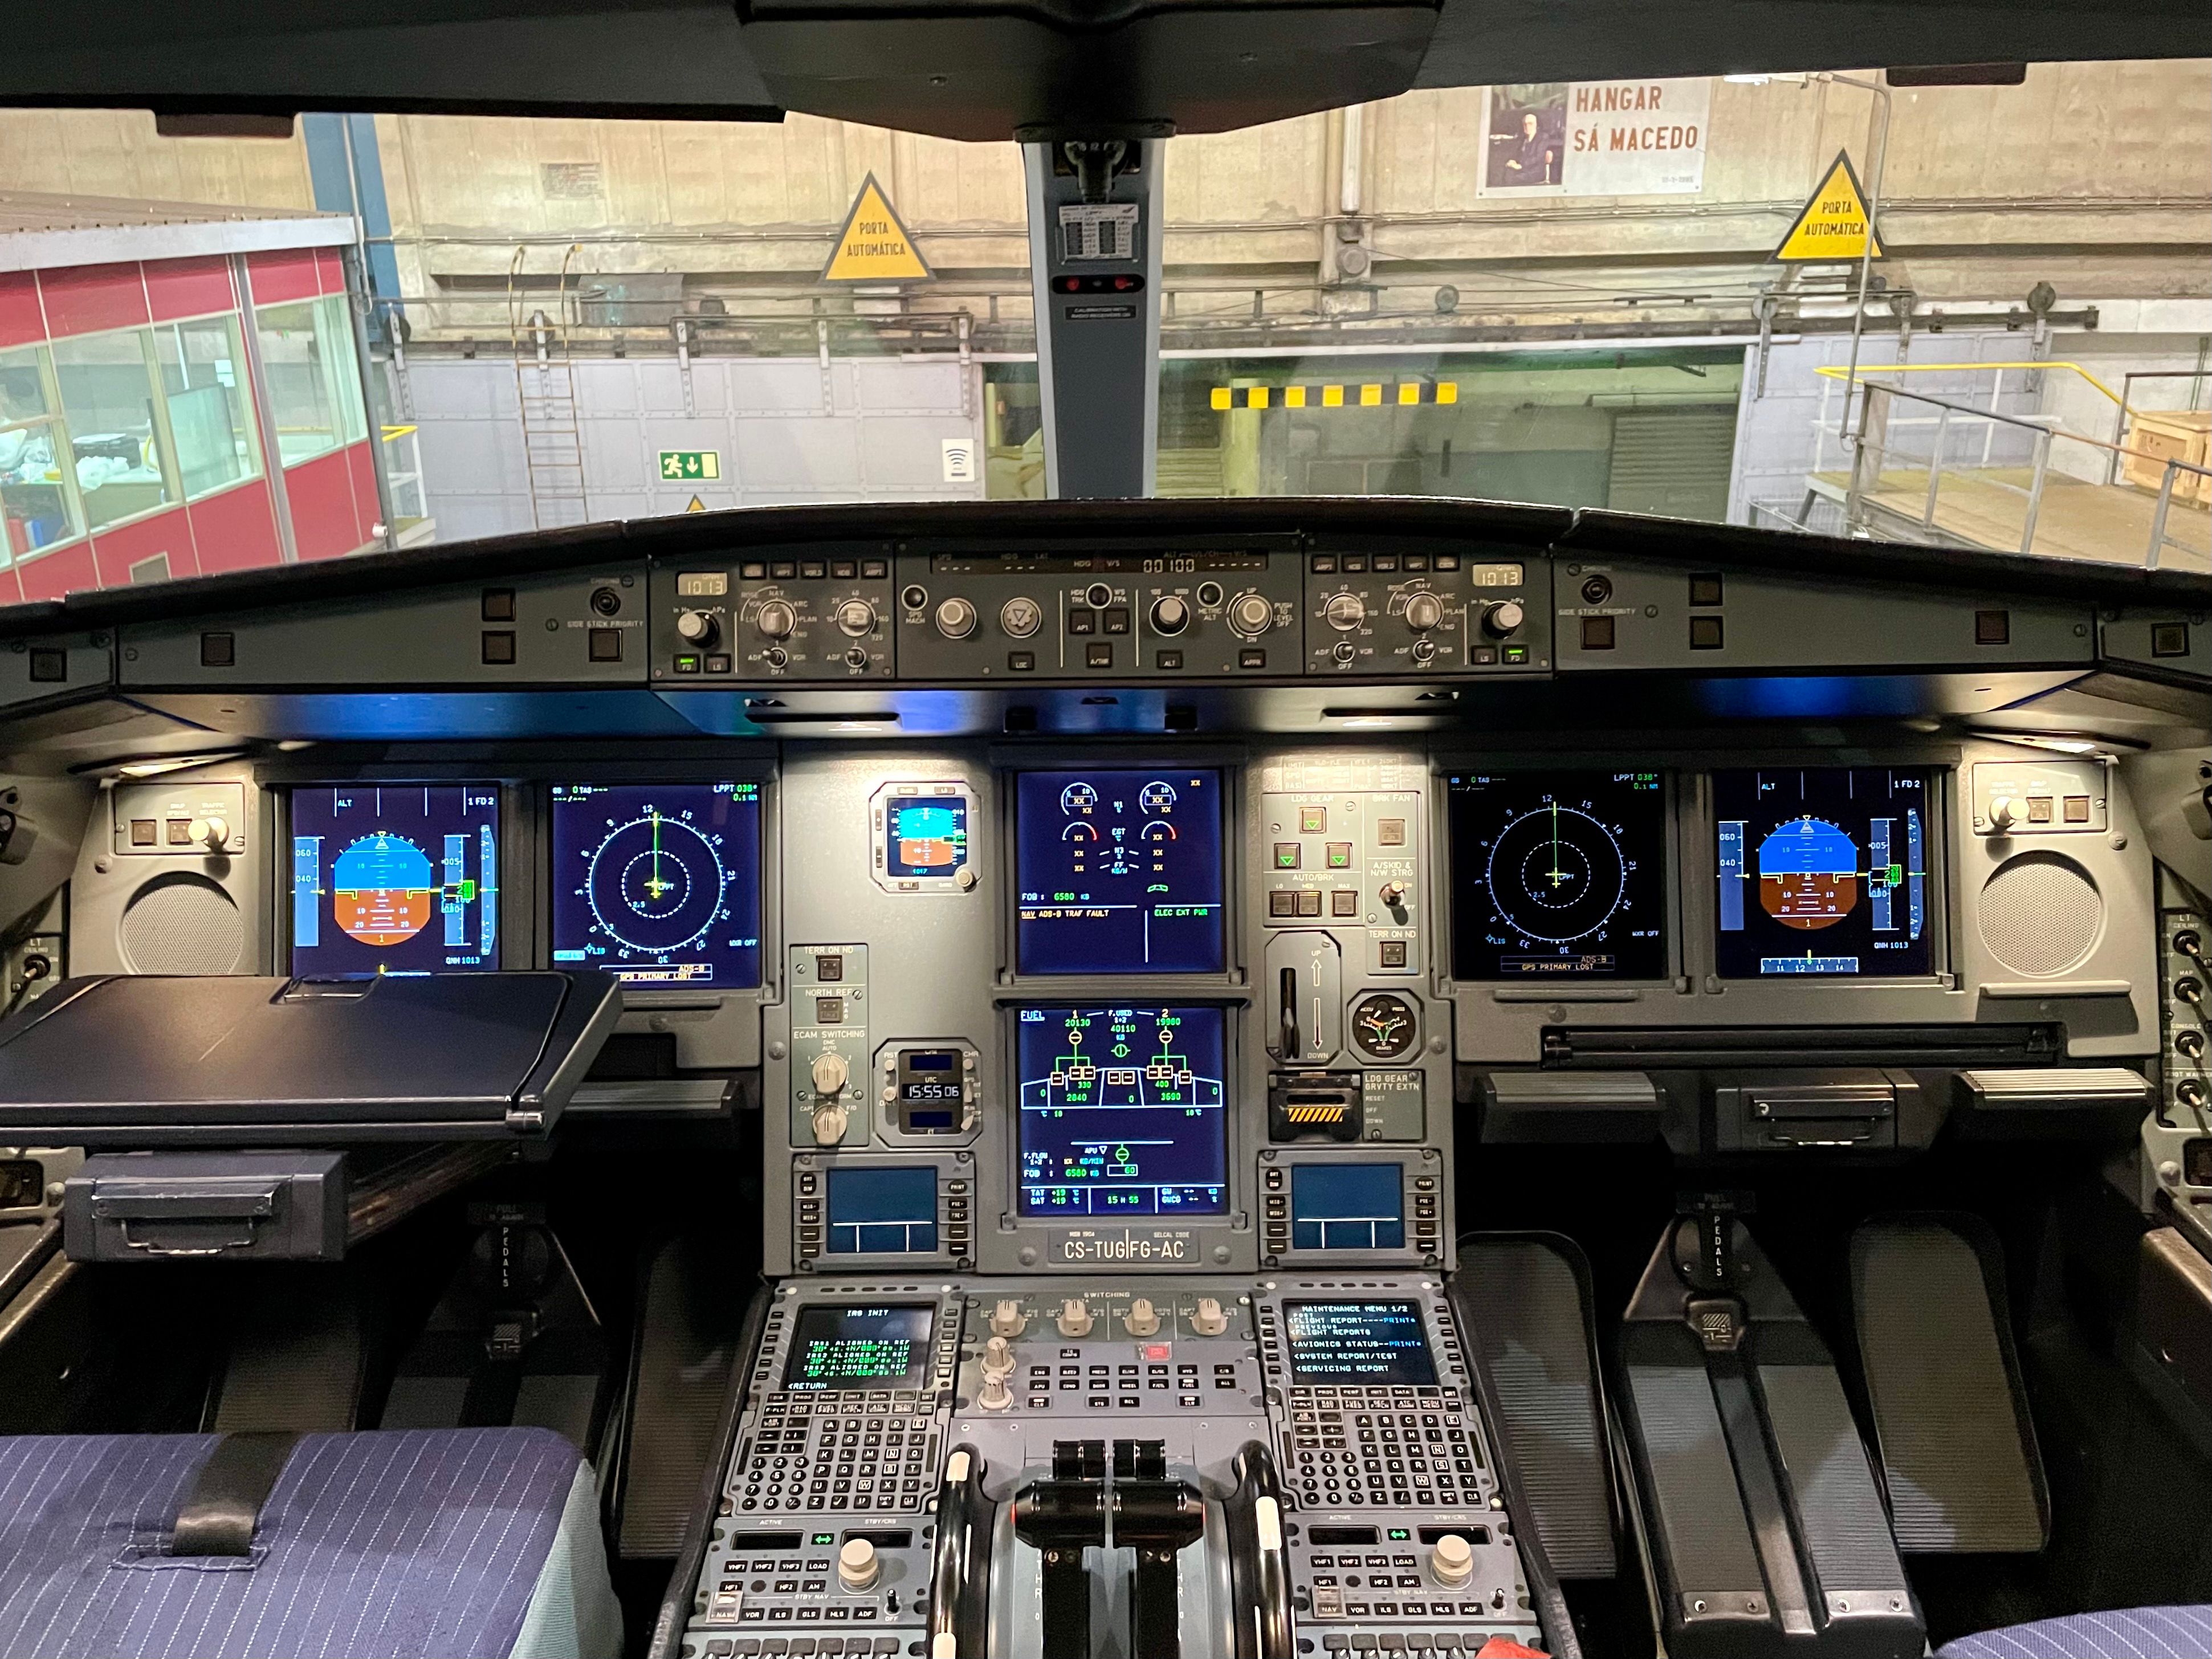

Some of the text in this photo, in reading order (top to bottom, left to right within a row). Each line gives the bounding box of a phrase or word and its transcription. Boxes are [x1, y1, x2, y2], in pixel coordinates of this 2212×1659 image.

[1575, 87, 1663, 112] HANGAR
[1573, 124, 1697, 152] SÁ MACEDO
[1822, 201, 1852, 214] PORTA
[859, 222, 889, 234] PORTA
[1804, 221, 1864, 236] AUTOMÁTICA
[847, 242, 906, 257] AUTOMÁTICA
[1482, 573, 1518, 585] 1013
[687, 581, 723, 594] 1013
[944, 1086, 959, 1097] 06
[1065, 1241, 1184, 1258] CS-TUG FG-AC
